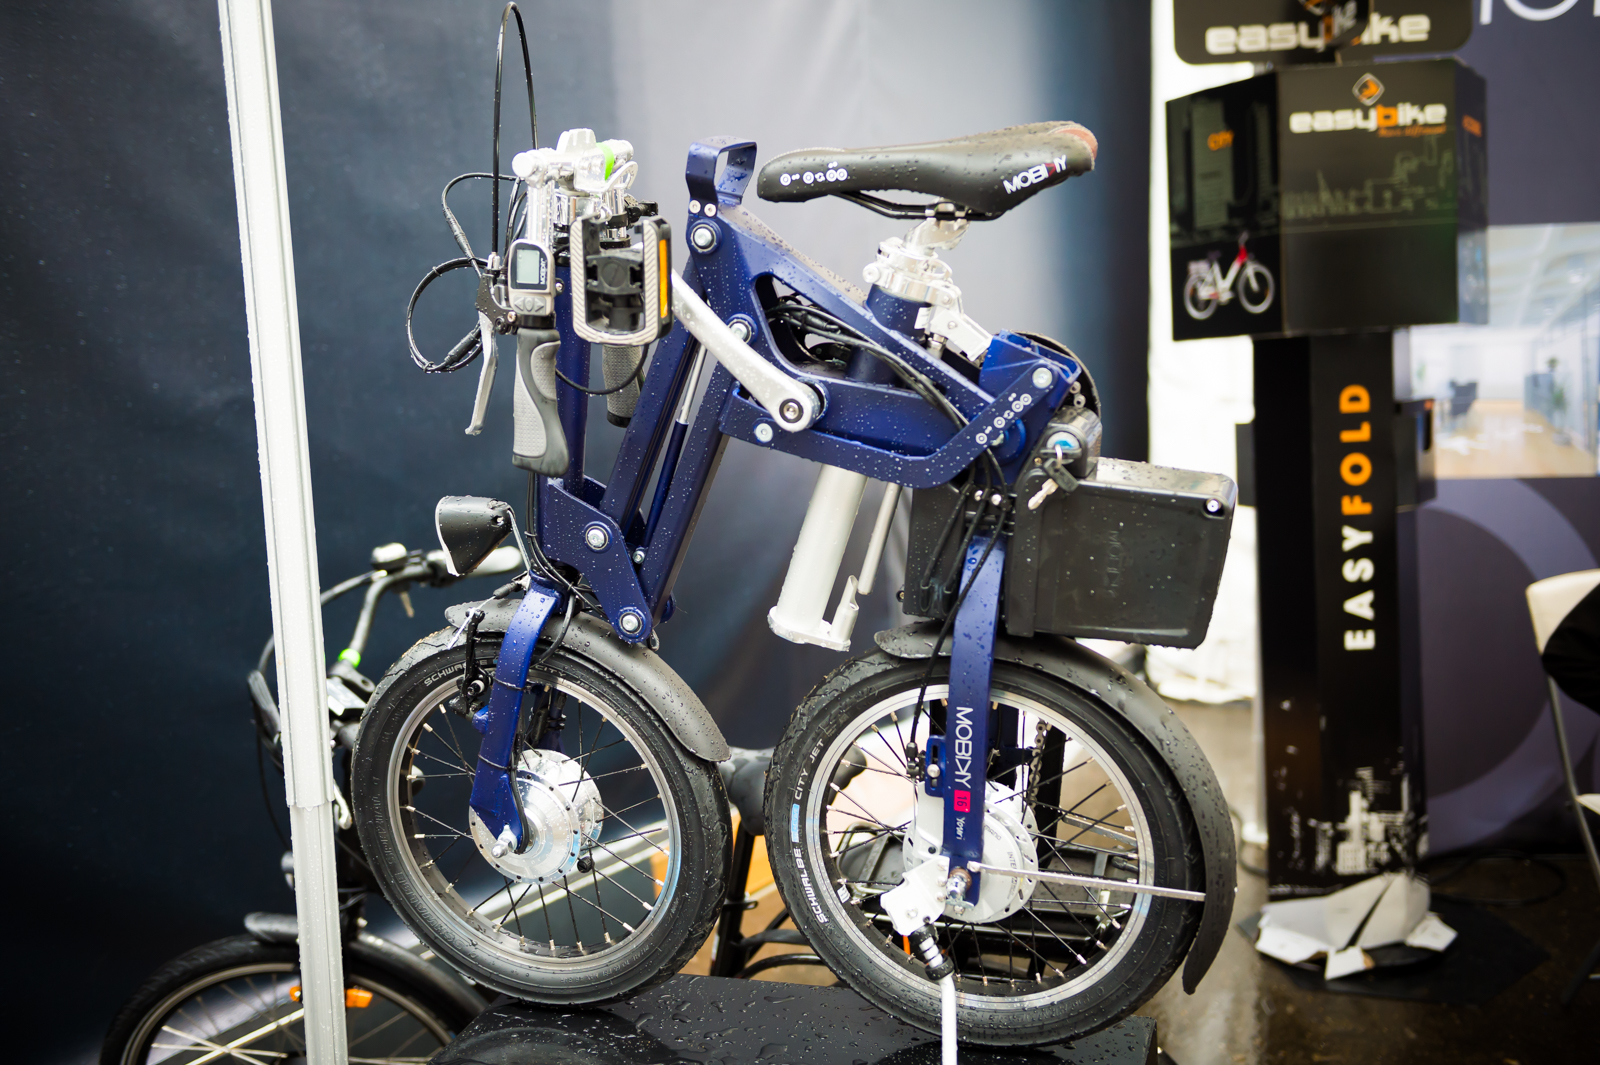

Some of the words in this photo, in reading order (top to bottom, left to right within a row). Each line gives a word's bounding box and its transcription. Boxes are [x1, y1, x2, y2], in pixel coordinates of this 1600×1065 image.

[1289, 102, 1447, 133] easybike
[1338, 384, 1376, 651] EASYFOLD
[424, 660, 488, 686] SCHWAE
[810, 738, 825, 763] JET
[955, 706, 973, 789] MOBIKY
[794, 768, 809, 800] CITY
[793, 847, 828, 924] SCHWALBE
